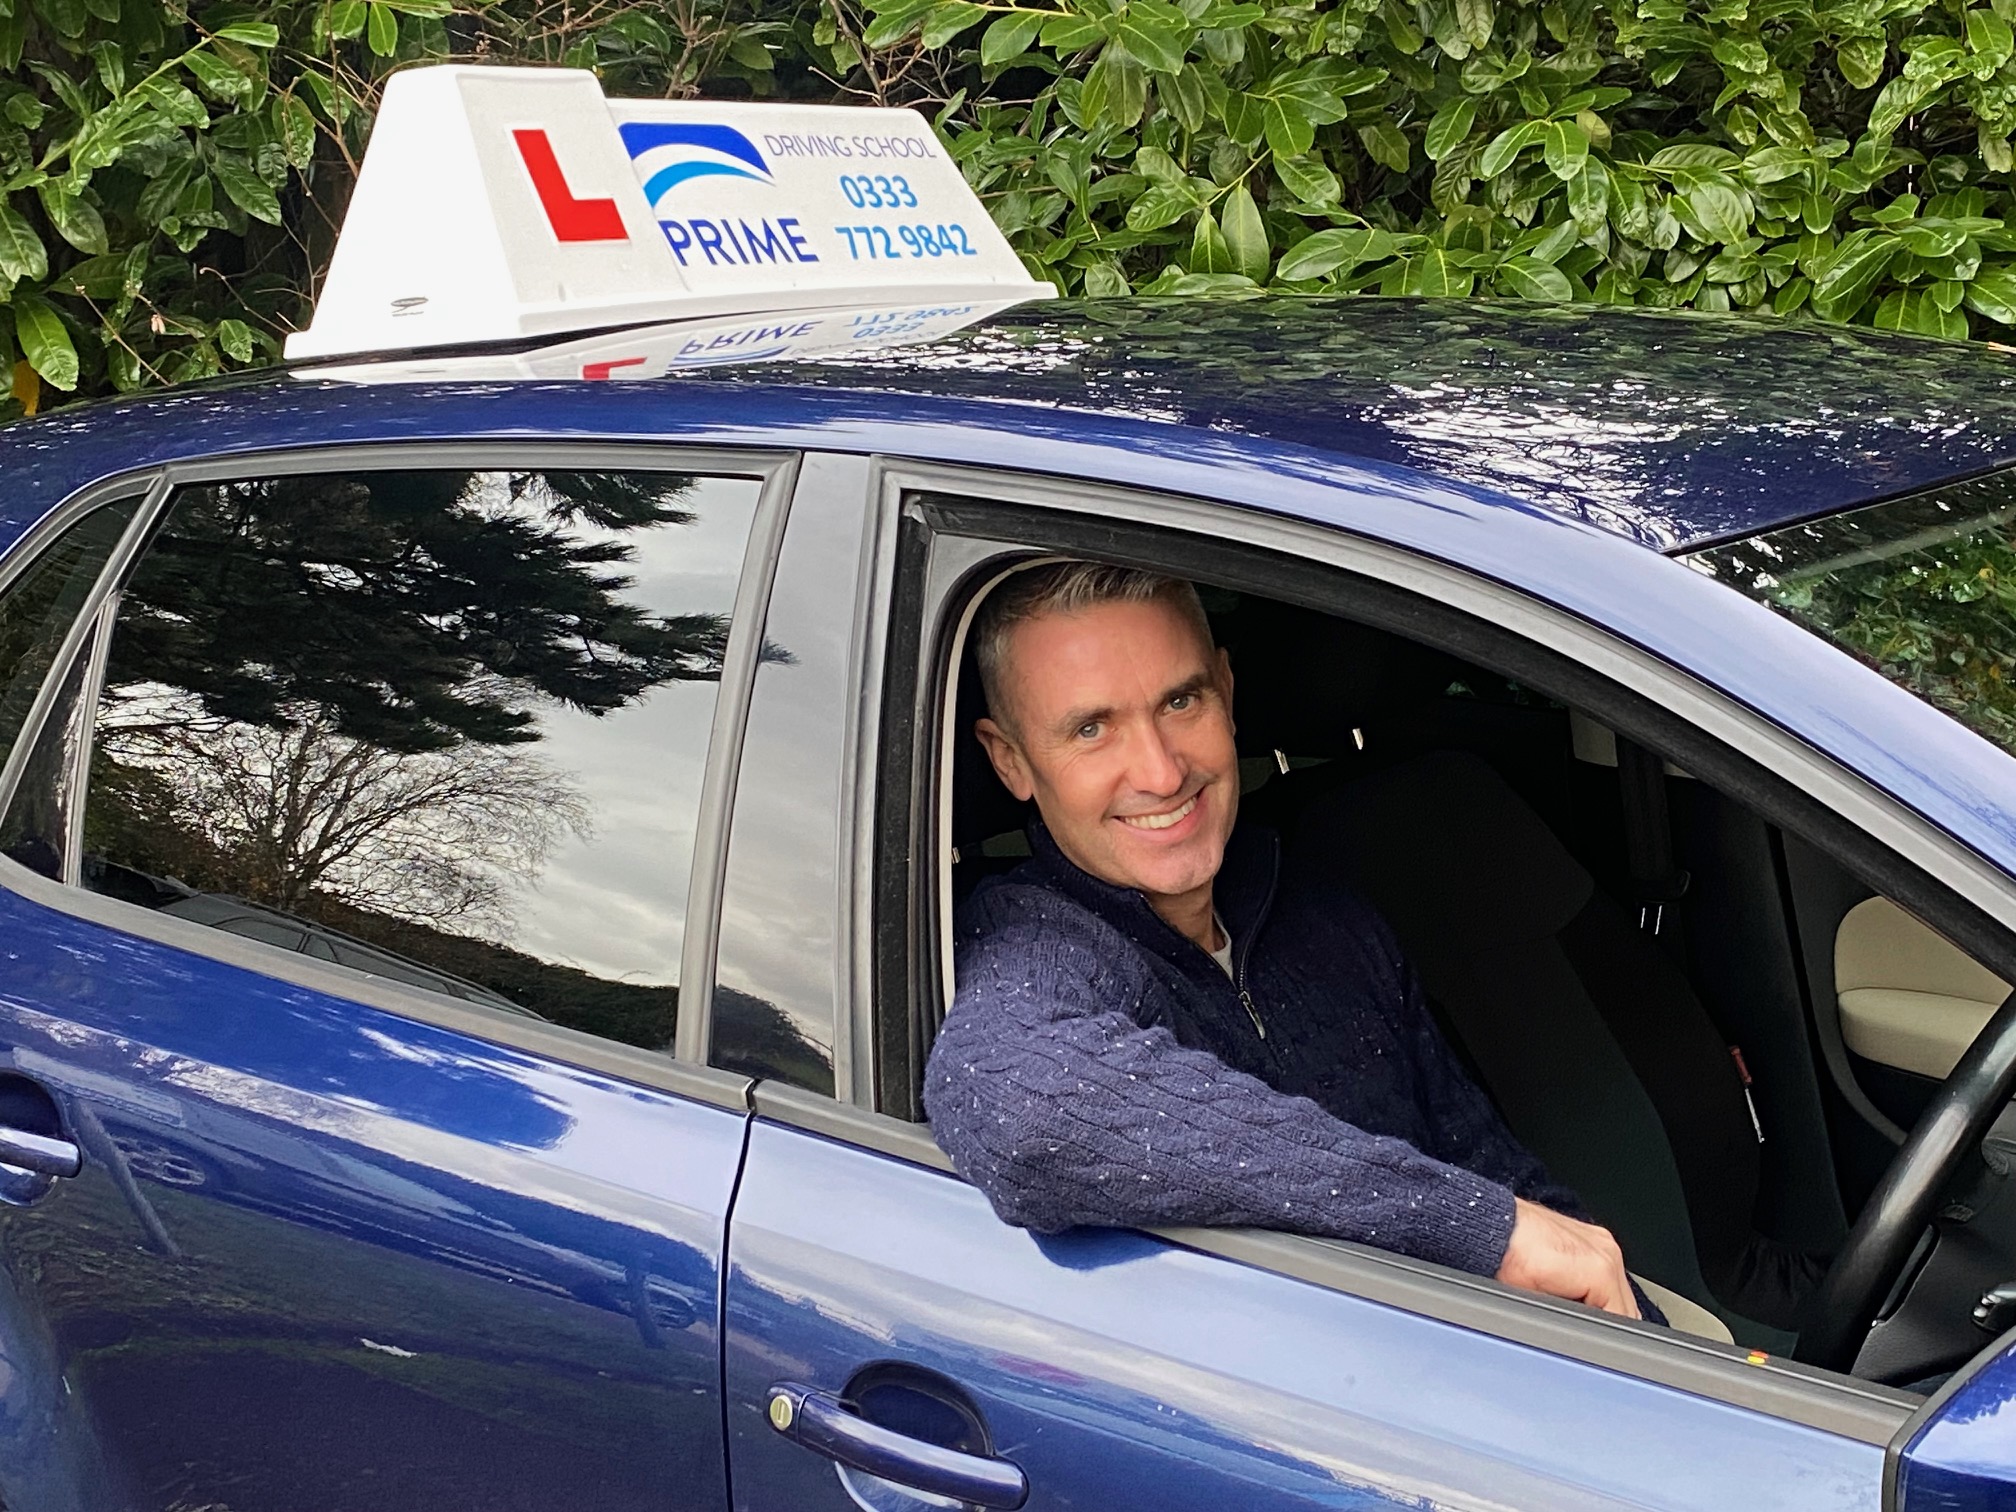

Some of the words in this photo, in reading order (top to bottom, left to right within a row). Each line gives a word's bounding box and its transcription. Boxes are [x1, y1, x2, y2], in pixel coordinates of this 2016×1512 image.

[764, 134, 852, 157] DRIVING
[852, 136, 937, 158] SCHOOL
[513, 129, 628, 242] L
[840, 174, 918, 208] 0333
[657, 217, 820, 267] PRIME
[834, 226, 901, 260] 772
[898, 223, 978, 258] 9842
